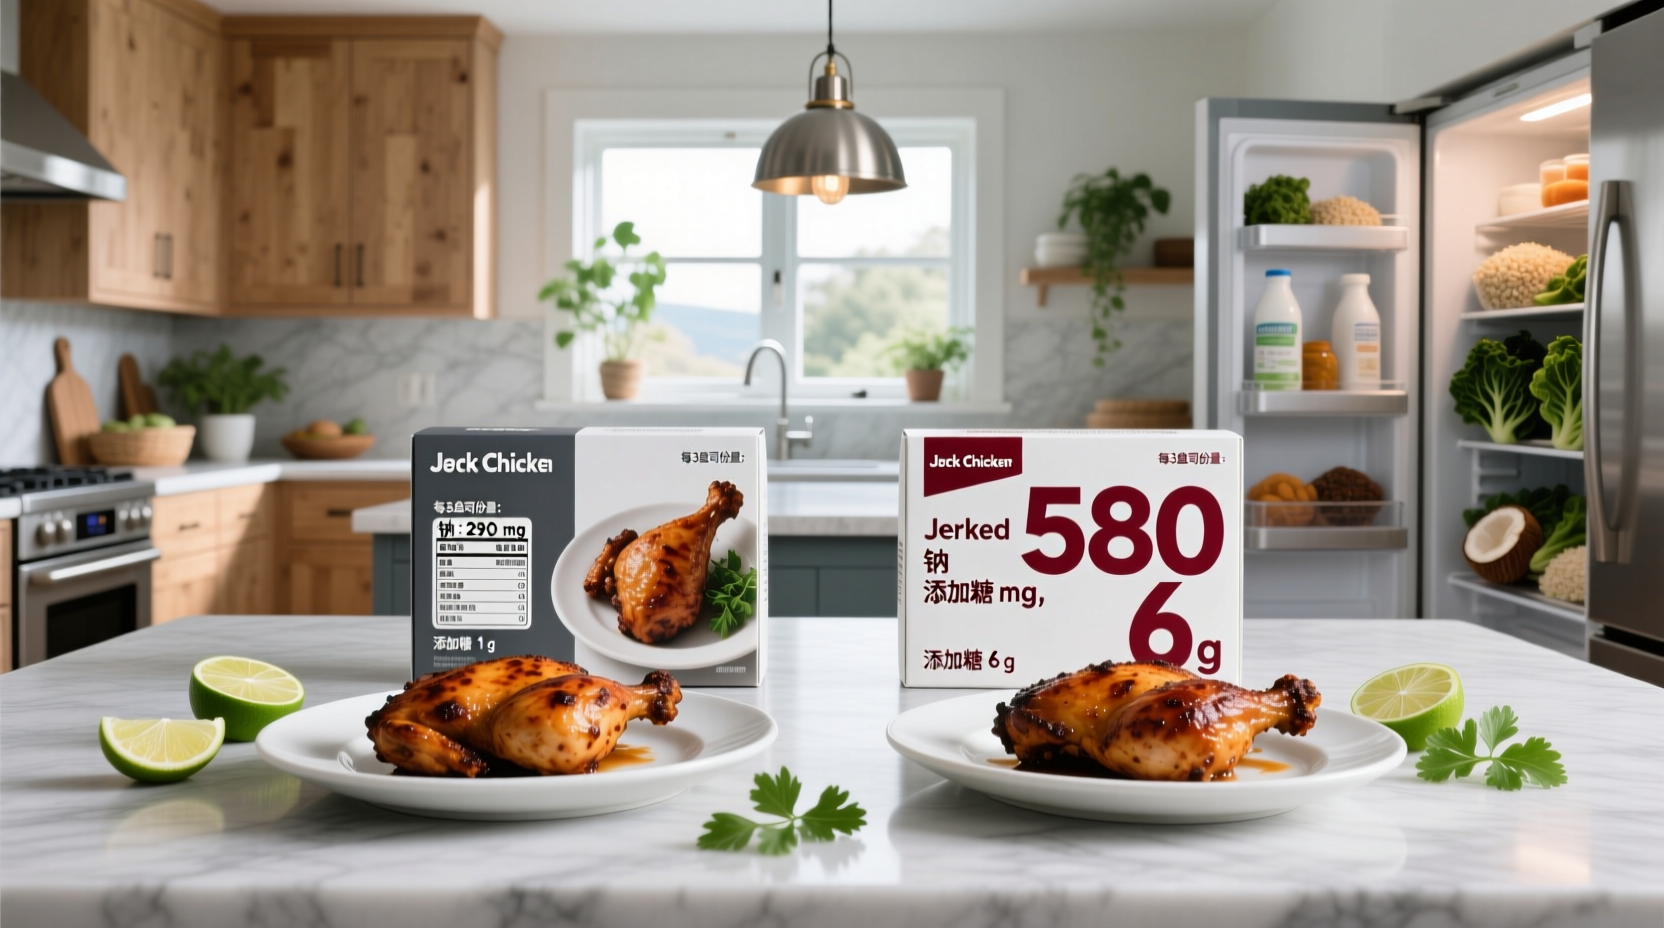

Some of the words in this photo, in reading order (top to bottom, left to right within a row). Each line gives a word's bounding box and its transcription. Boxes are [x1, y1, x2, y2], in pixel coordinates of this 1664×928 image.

[466, 521, 498, 537] 290
[503, 525, 526, 540] mg
[924, 518, 1010, 540] Jerked
[1021, 485, 1225, 576] 580
[923, 548, 949, 574] 钠
[923, 579, 994, 604] 添加糖
[999, 586, 1045, 609] mg,
[1129, 581, 1193, 668] 6
[1197, 640, 1221, 675] g
[477, 635, 484, 650] 1
[487, 640, 496, 653] g
[923, 649, 983, 671] 添加糖
[988, 650, 1000, 669] 6
[1004, 656, 1015, 674] g
